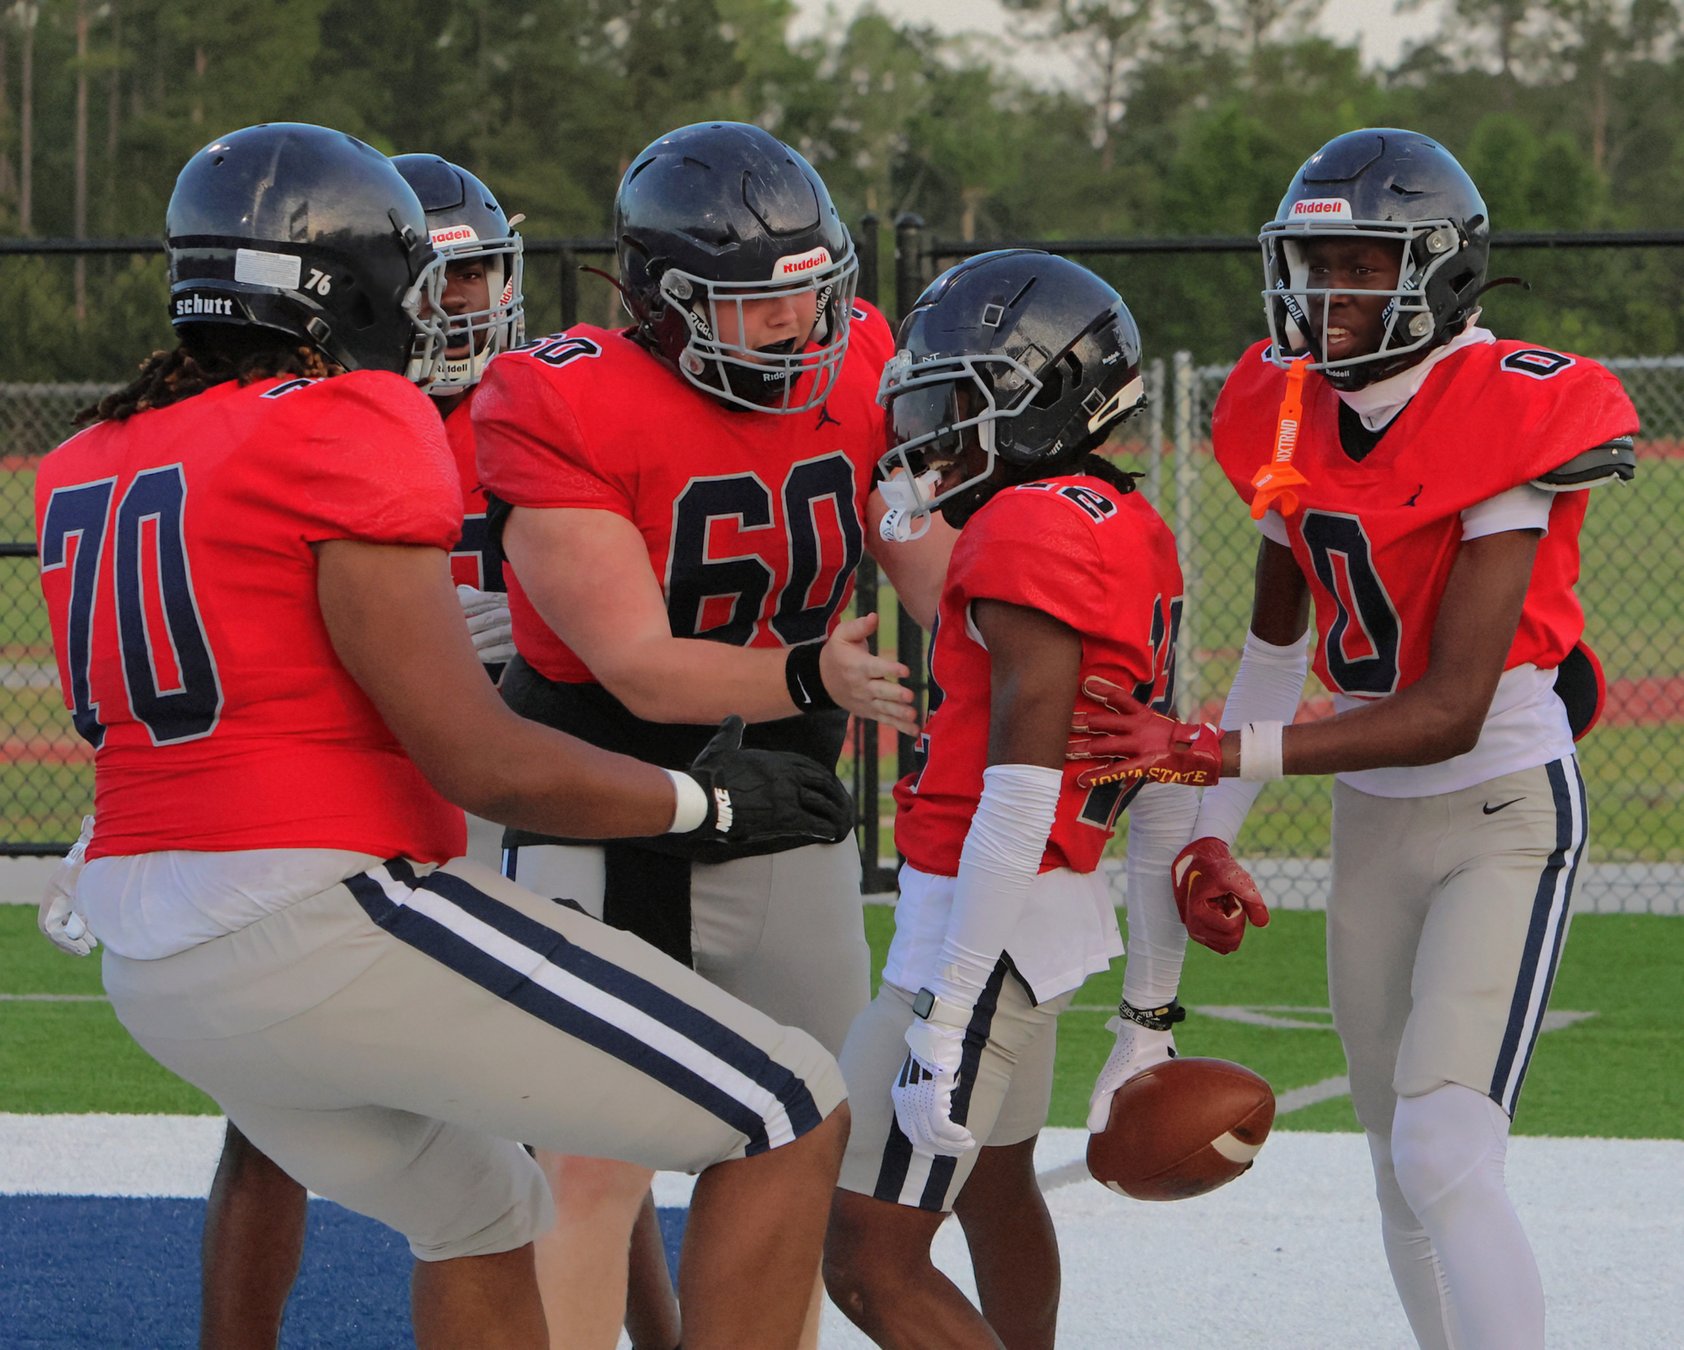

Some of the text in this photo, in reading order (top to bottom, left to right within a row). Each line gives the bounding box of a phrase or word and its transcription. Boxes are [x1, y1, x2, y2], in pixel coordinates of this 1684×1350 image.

[1294, 201, 1342, 214] Riddell
[783, 252, 827, 273] Riddell
[304, 268, 333, 296] 76
[176, 293, 233, 316] schutt
[1500, 349, 1576, 380] 0
[1276, 419, 1298, 463] NXTRND
[664, 449, 865, 648] 60
[41, 462, 224, 750] 70
[1299, 507, 1402, 696] 0
[1149, 767, 1208, 783] STATE
[714, 787, 733, 833] NIKE
